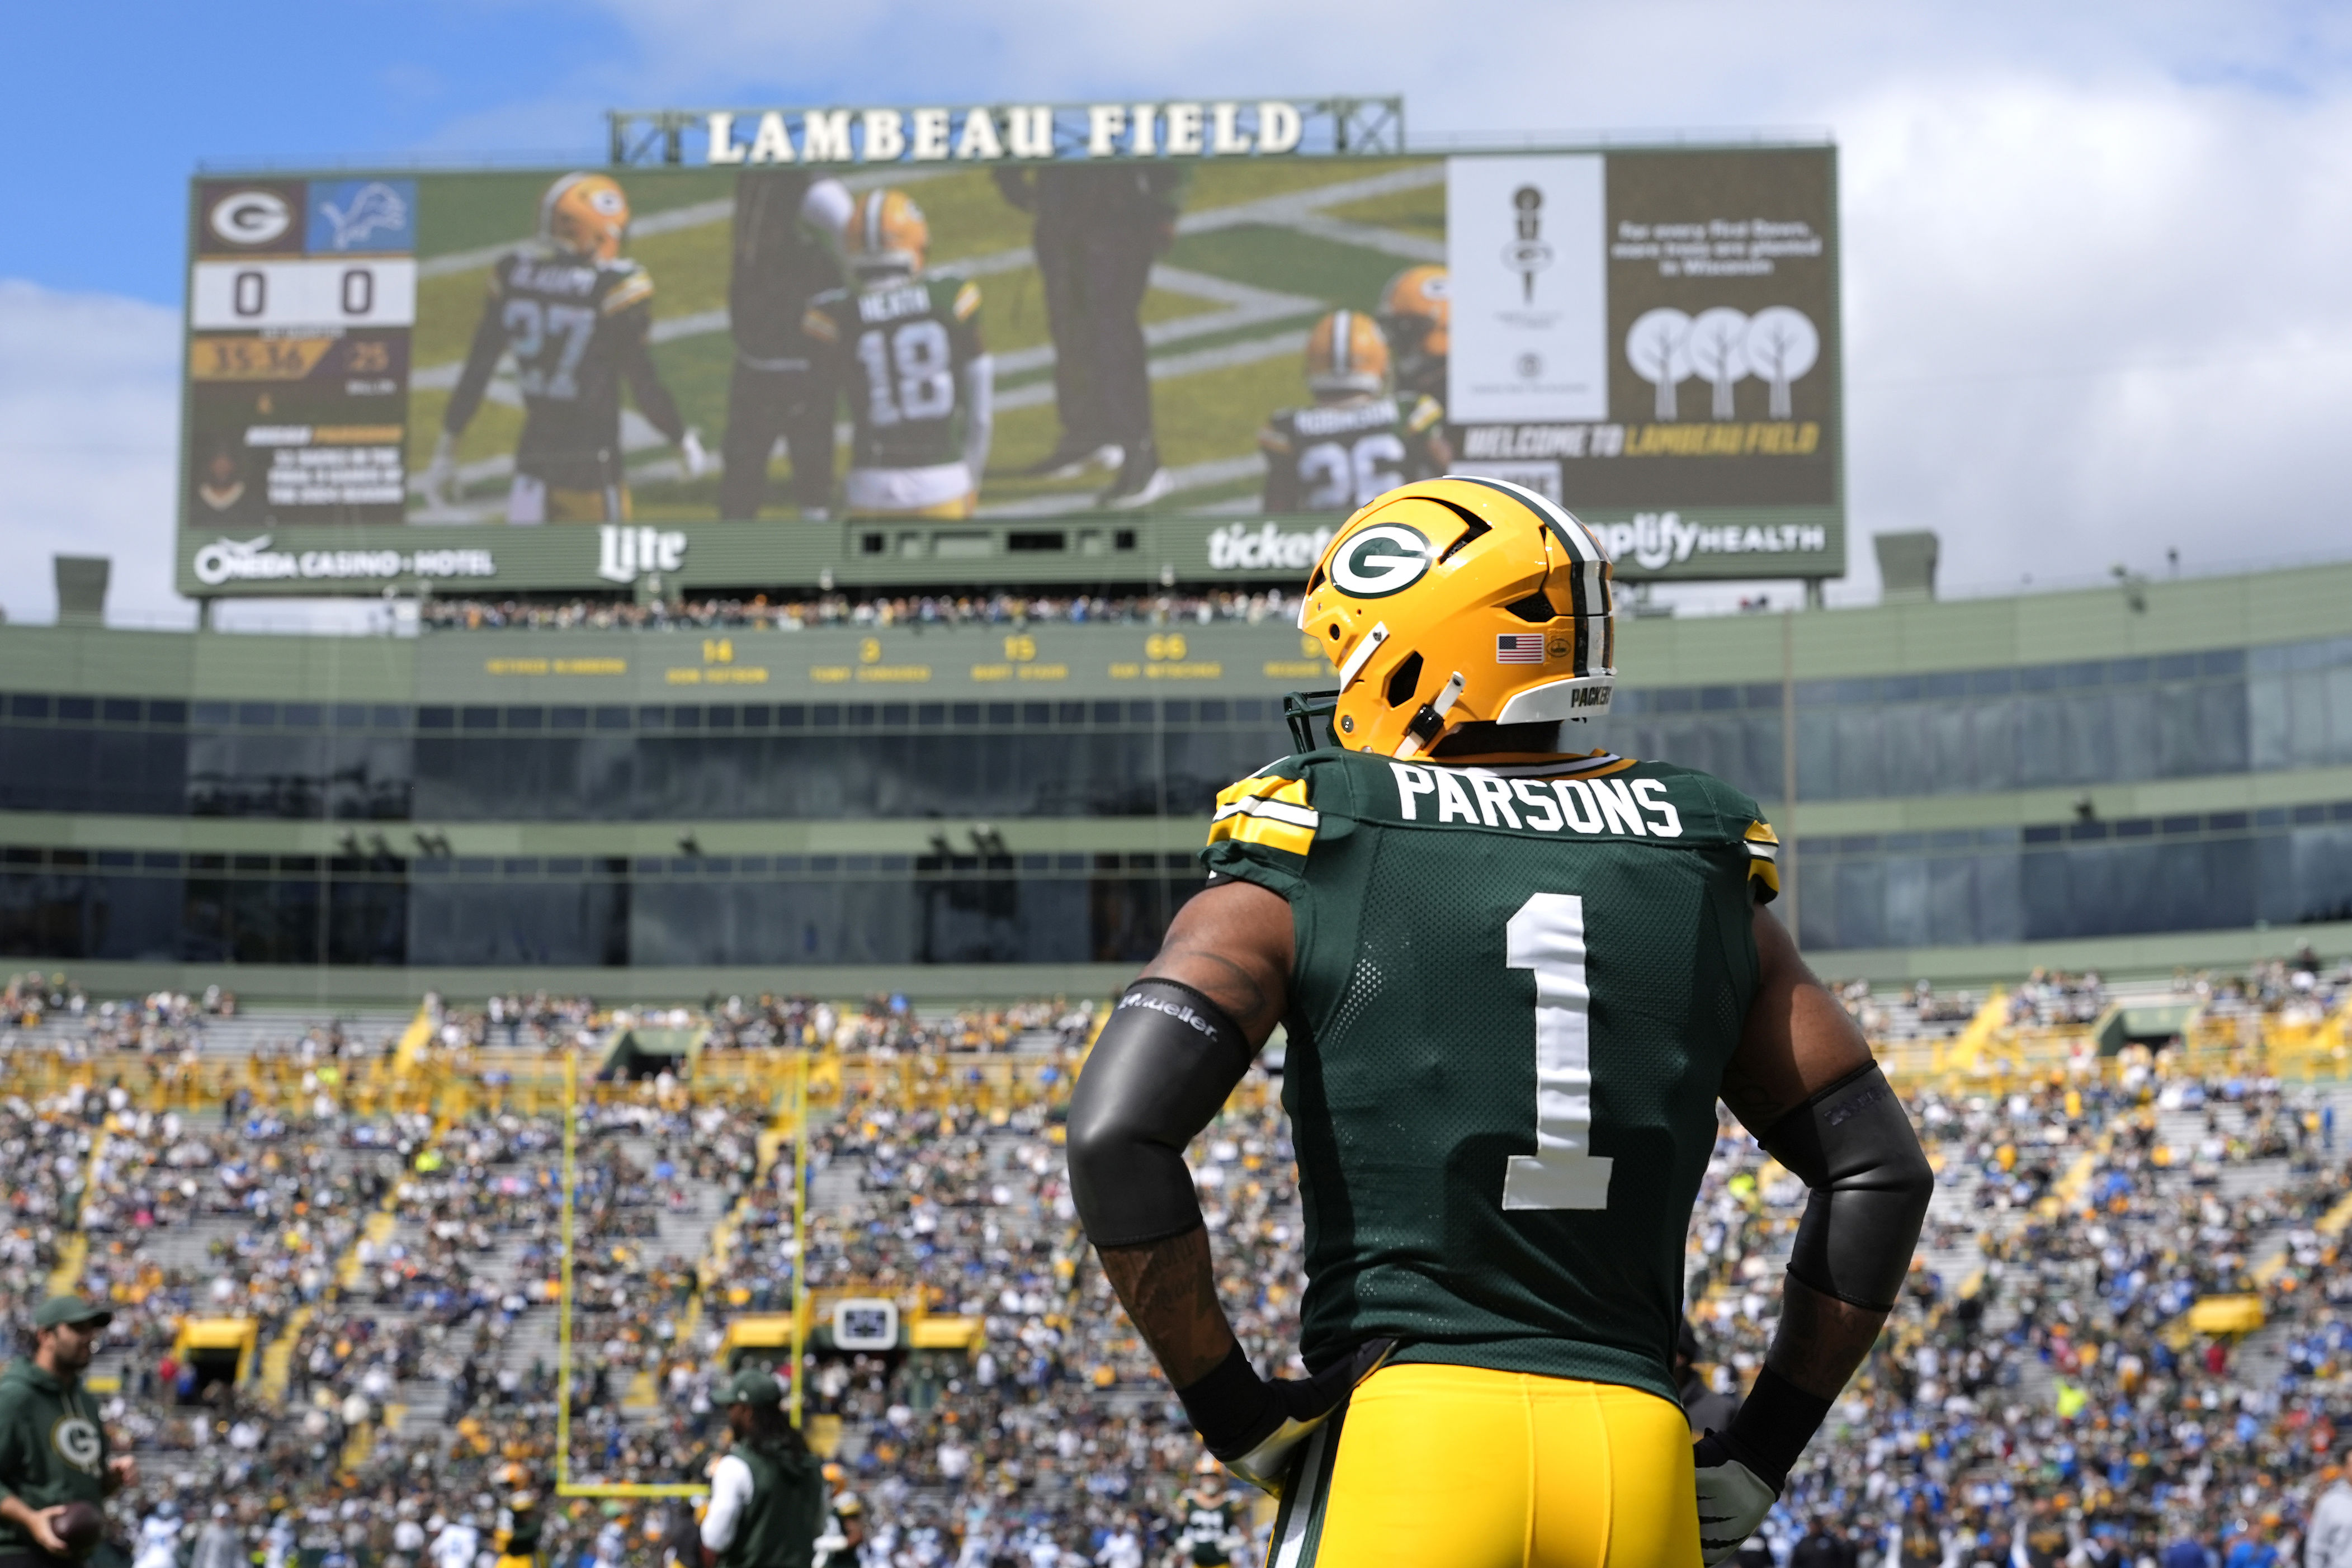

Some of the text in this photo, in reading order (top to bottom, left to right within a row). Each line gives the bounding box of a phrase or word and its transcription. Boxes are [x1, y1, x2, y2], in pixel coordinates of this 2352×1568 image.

[707, 102, 1302, 164] LAMBEAU FIELD
[211, 191, 290, 244] G
[235, 270, 372, 322] 0 0
[501, 299, 596, 402] 27
[856, 319, 955, 426] 18
[1463, 421, 1820, 459] WELCOME TO LAMBEAU FIELD
[194, 544, 498, 584] ONEIDA CASINO HOTEL
[598, 525, 688, 583] Lite
[1331, 525, 1429, 594] G
[1698, 523, 1826, 554] HEALTH
[702, 638, 733, 664] 14
[1003, 634, 1037, 662] 15
[1388, 762, 1684, 838] PARSONS
[1502, 892, 1614, 1211] 1
[55, 1416, 102, 1465] G
